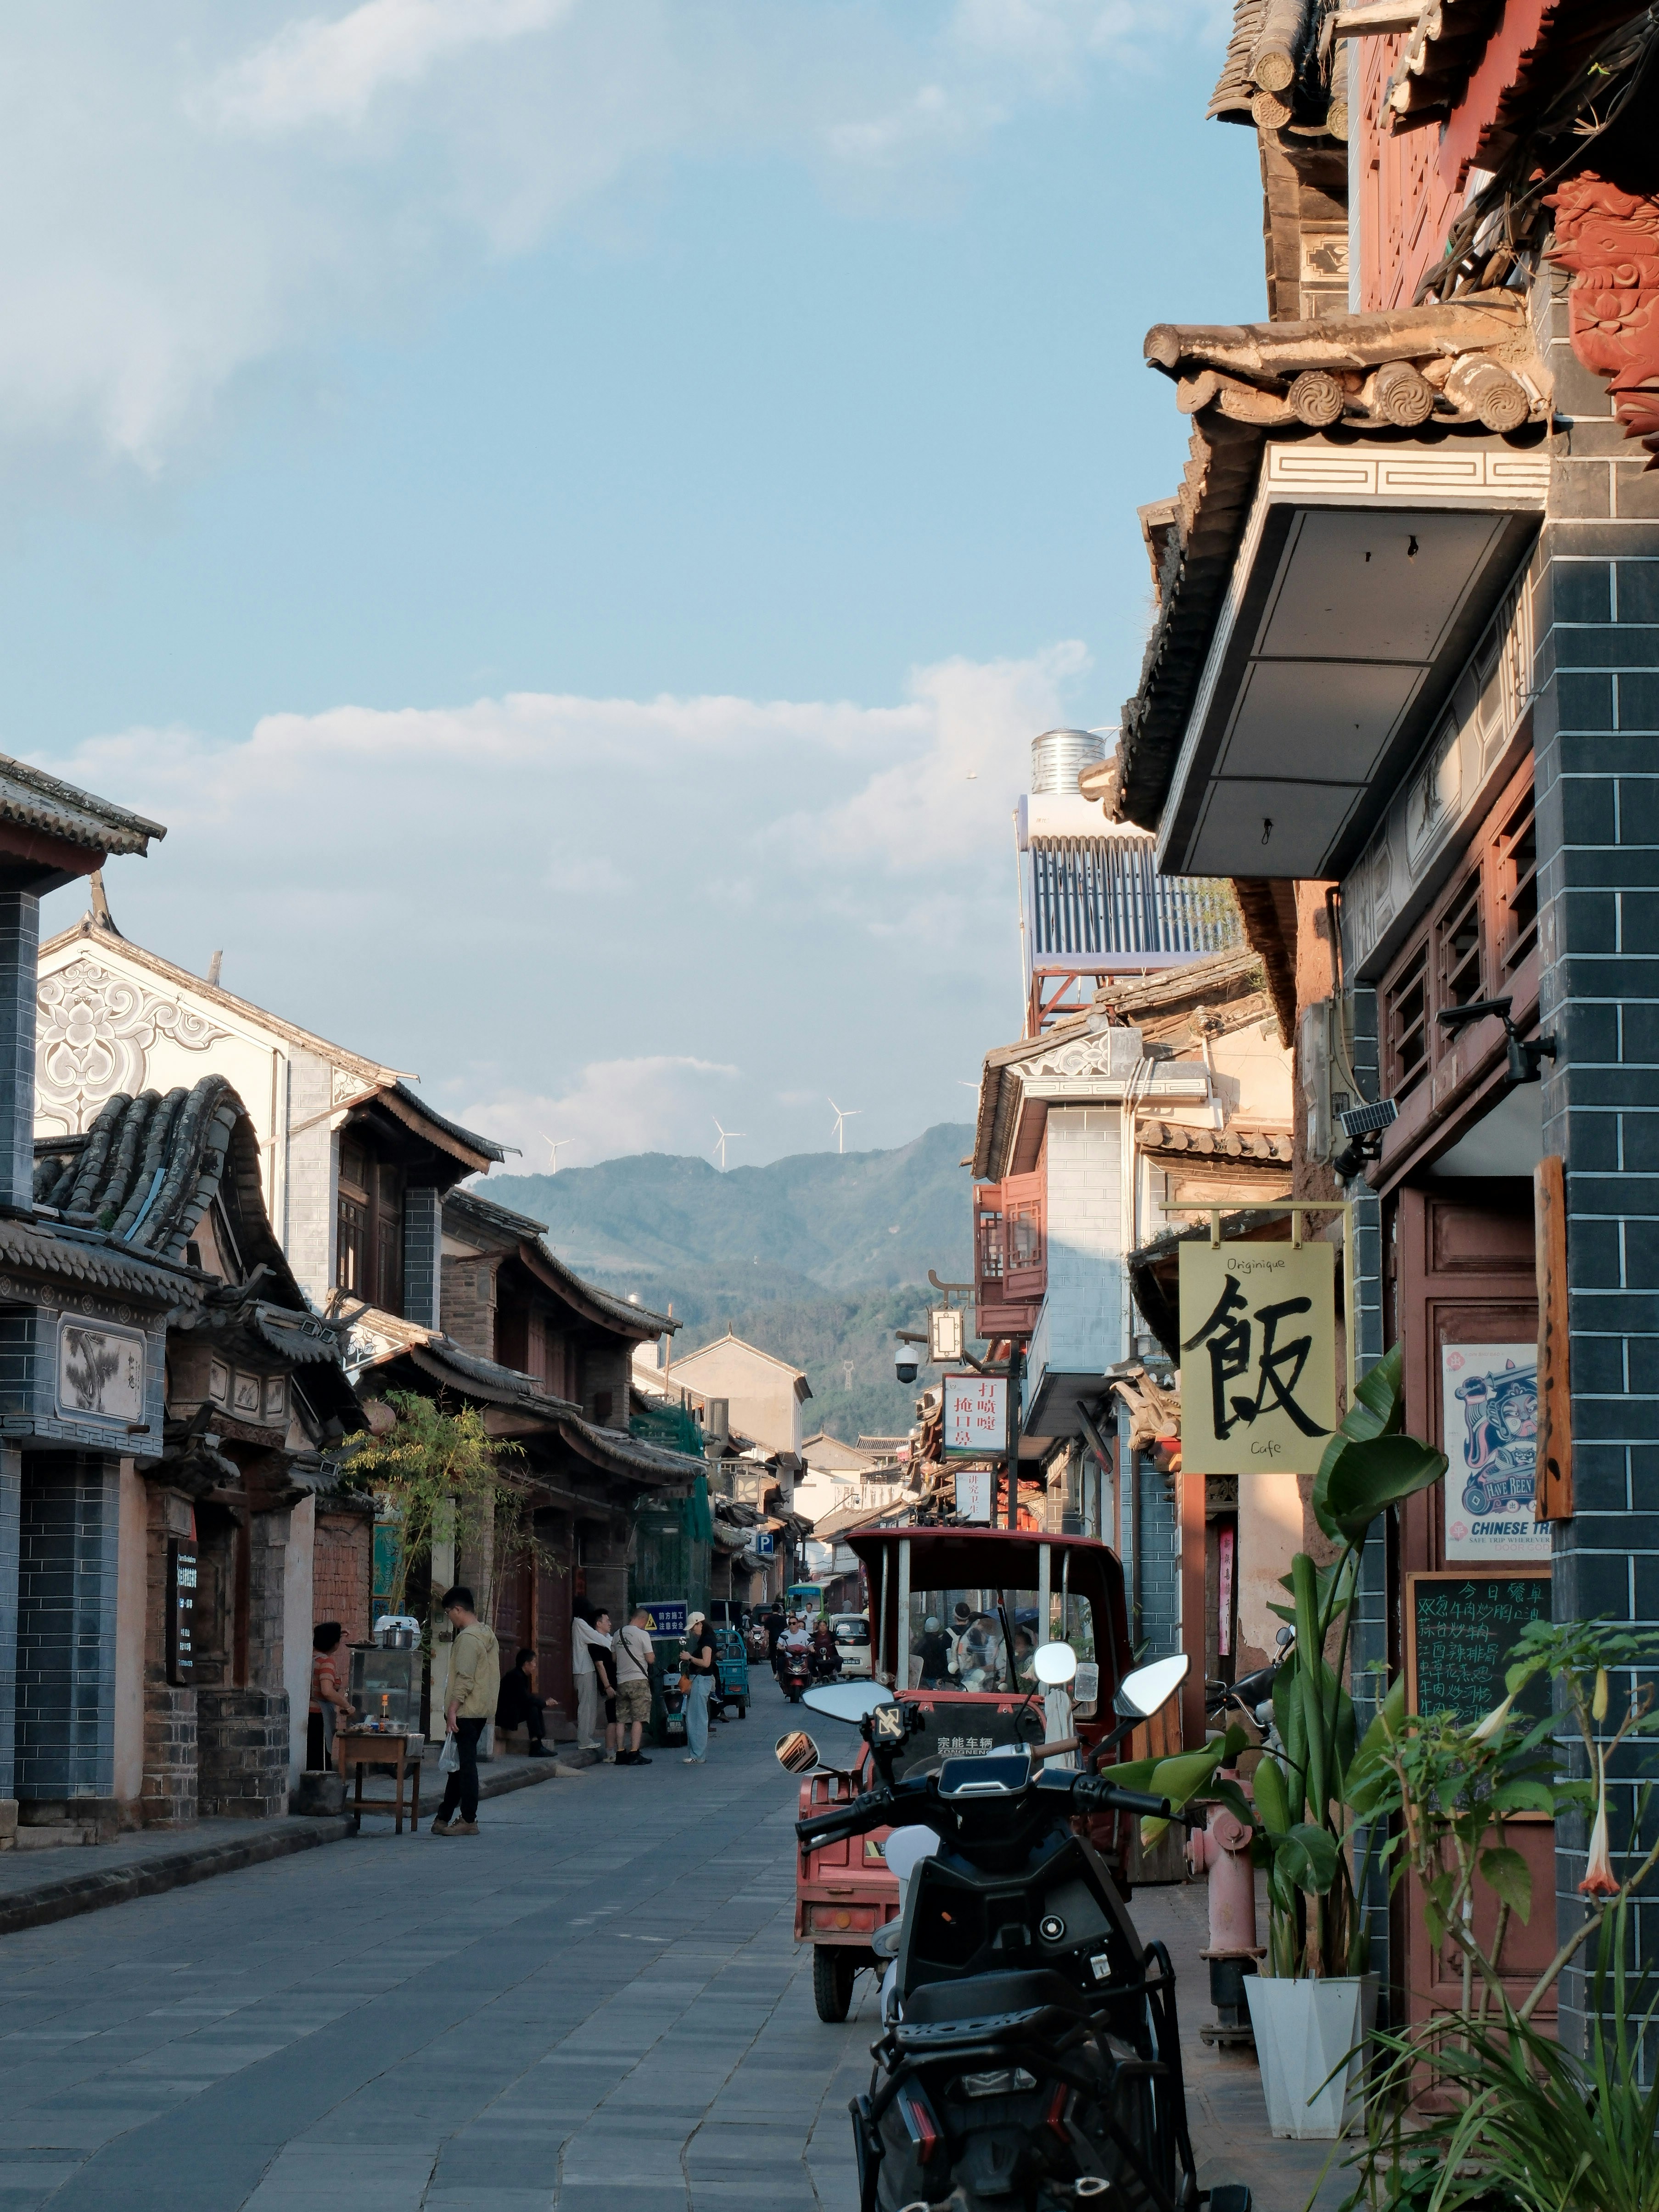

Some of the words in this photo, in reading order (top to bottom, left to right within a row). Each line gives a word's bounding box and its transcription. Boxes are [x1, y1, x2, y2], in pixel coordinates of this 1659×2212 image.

[1227, 1258, 1286, 1274] Originique
[1180, 1274, 1336, 1440] 飯
[977, 1382, 997, 1430] 打喷嚏
[953, 1397, 973, 1446] 掩口鼻
[1251, 1441, 1281, 1457] Cafe
[969, 1475, 979, 1513] 讲究卫生
[1486, 1482, 1508, 1499] HAVE
[1454, 1525, 1465, 1537] 平
[1471, 1521, 1529, 1535] CHINESE
[761, 1536, 770, 1550] P
[659, 1622, 684, 1630] 注意安全
[937, 1737, 993, 1748] 宗能车辆
